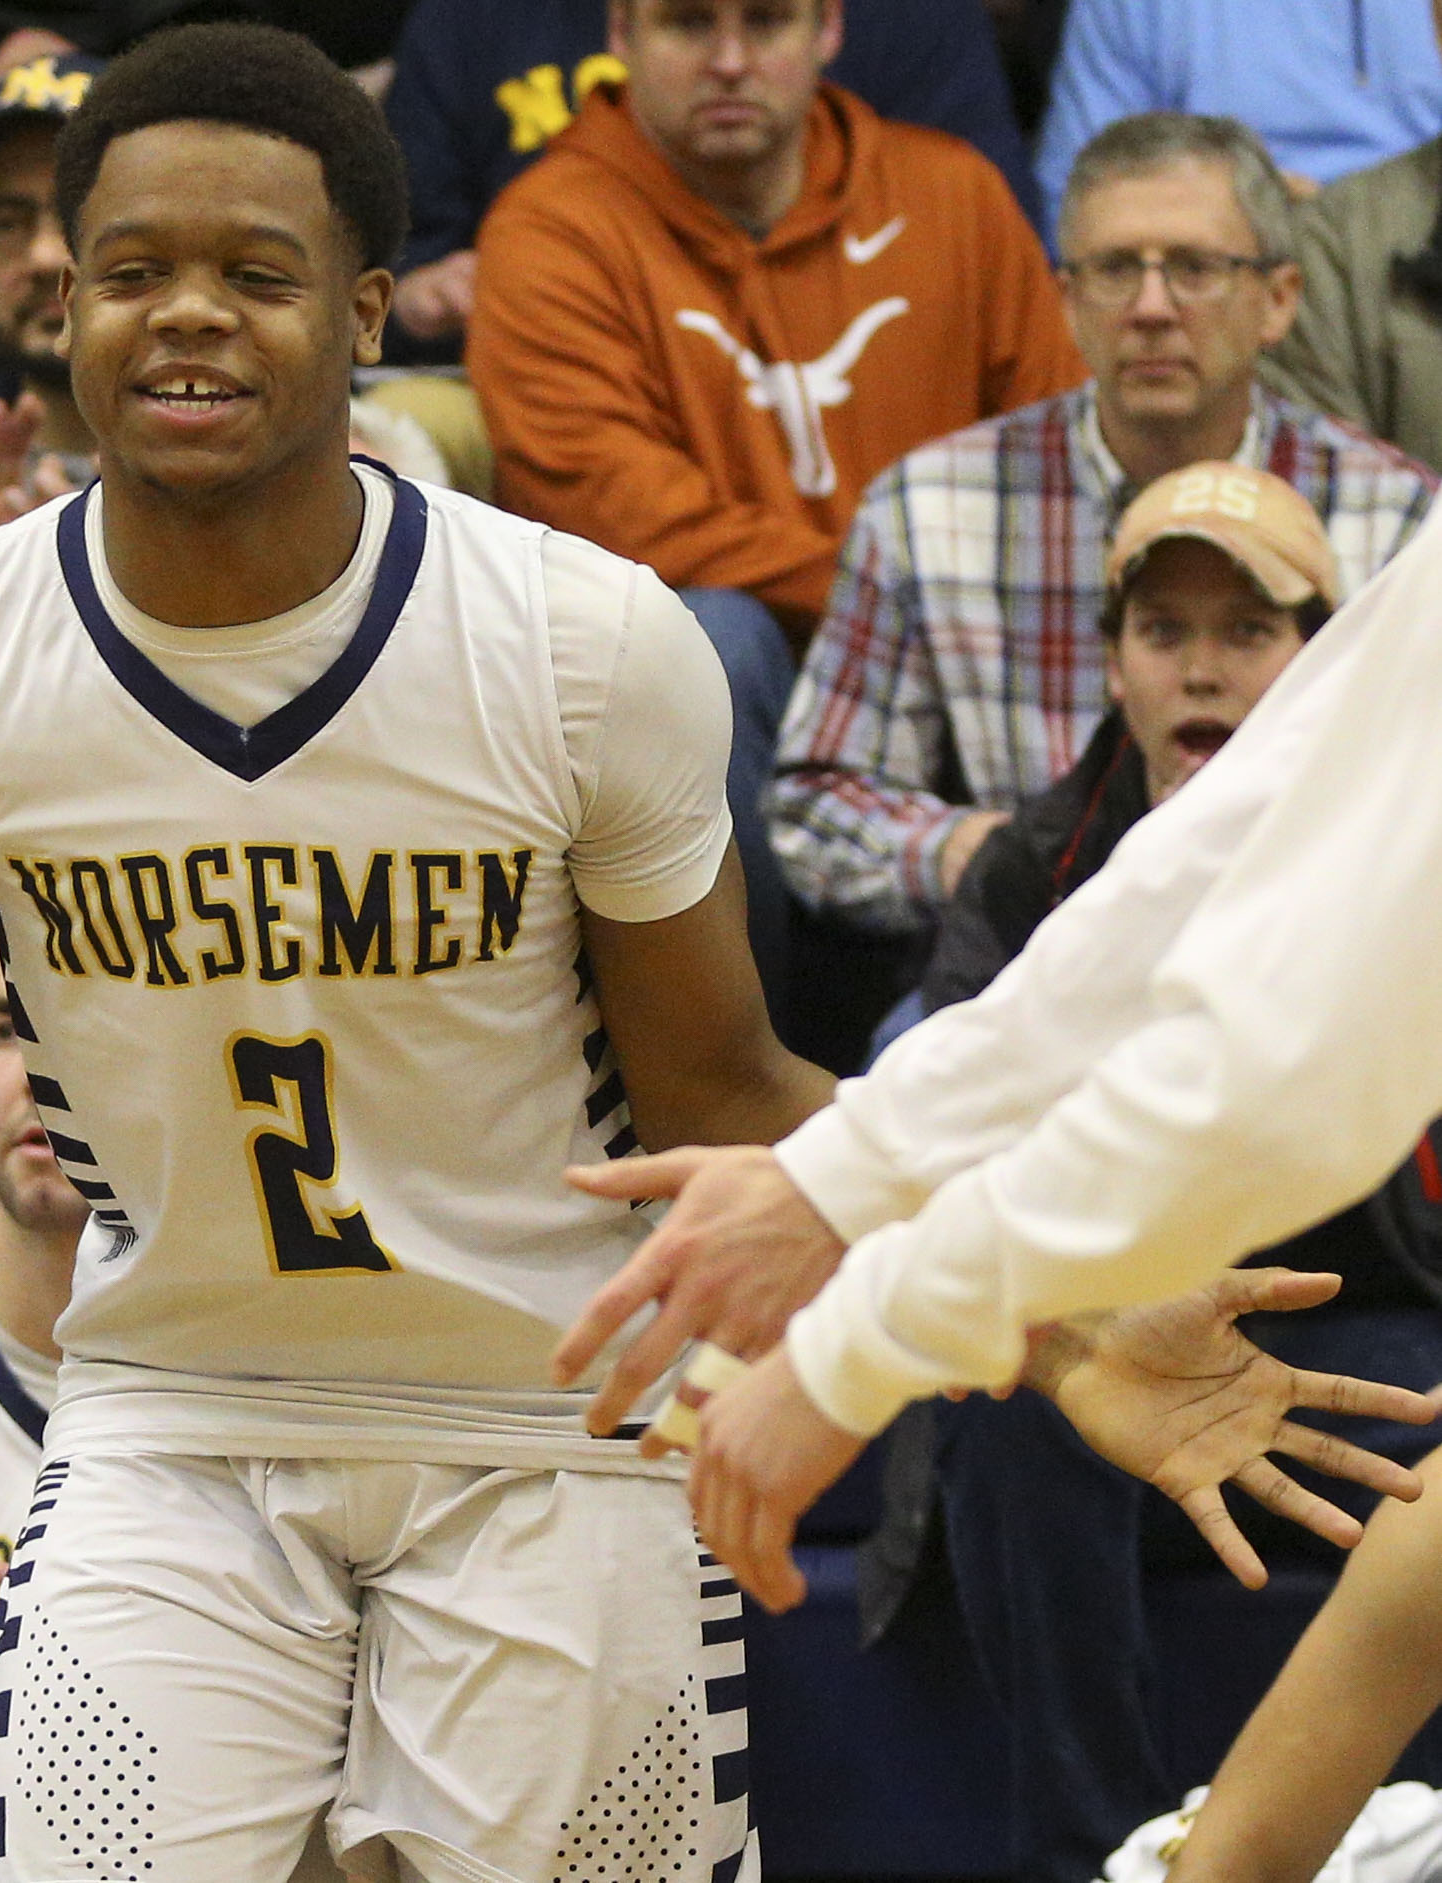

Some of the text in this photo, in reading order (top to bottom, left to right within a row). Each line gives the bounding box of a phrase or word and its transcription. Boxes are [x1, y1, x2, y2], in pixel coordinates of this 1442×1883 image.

[1172, 471, 1260, 520] 25
[7, 842, 534, 988] NORSEMEN
[225, 1029, 404, 1276] 2
